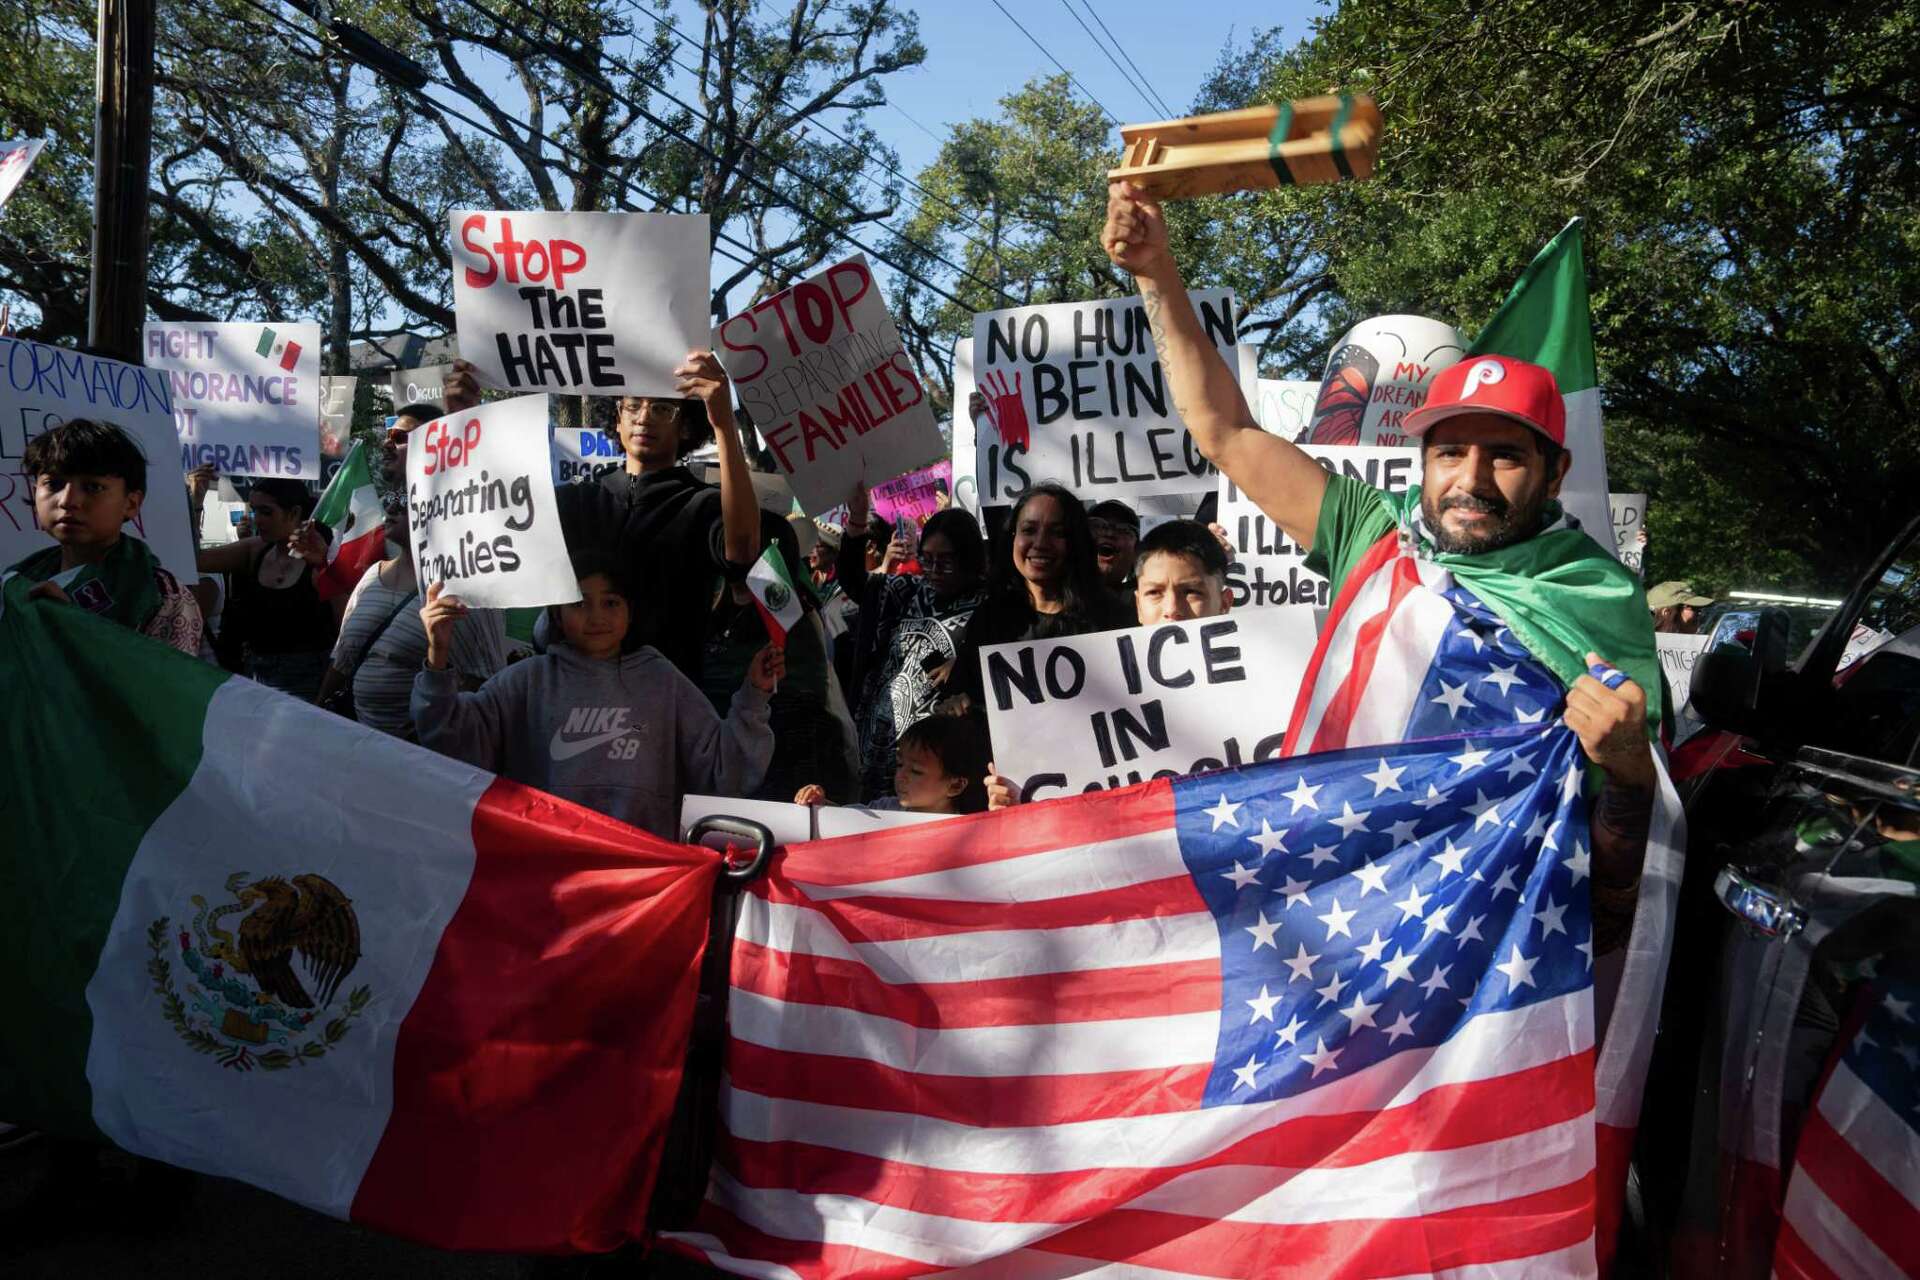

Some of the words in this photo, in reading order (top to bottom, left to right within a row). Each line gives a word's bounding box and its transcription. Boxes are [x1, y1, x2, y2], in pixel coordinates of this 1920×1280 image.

[147, 330, 218, 359] FIGHT
[720, 262, 870, 383] STOP
[987, 313, 1049, 364] NO
[1073, 297, 1237, 359] HUN
[169, 370, 298, 405] NORANCE
[496, 333, 626, 387] HATE
[743, 320, 900, 426] SEPARATING
[1393, 361, 1429, 382] MY
[763, 350, 923, 473] FAMILIES
[1032, 360, 1168, 425] BEIN
[1377, 409, 1409, 428] AR
[988, 442, 1032, 501] IS
[987, 645, 1086, 711] NO
[1116, 620, 1246, 694] ICE
[562, 707, 632, 733] NIKE
[608, 738, 641, 760] SB
[1090, 699, 1171, 768] IN
